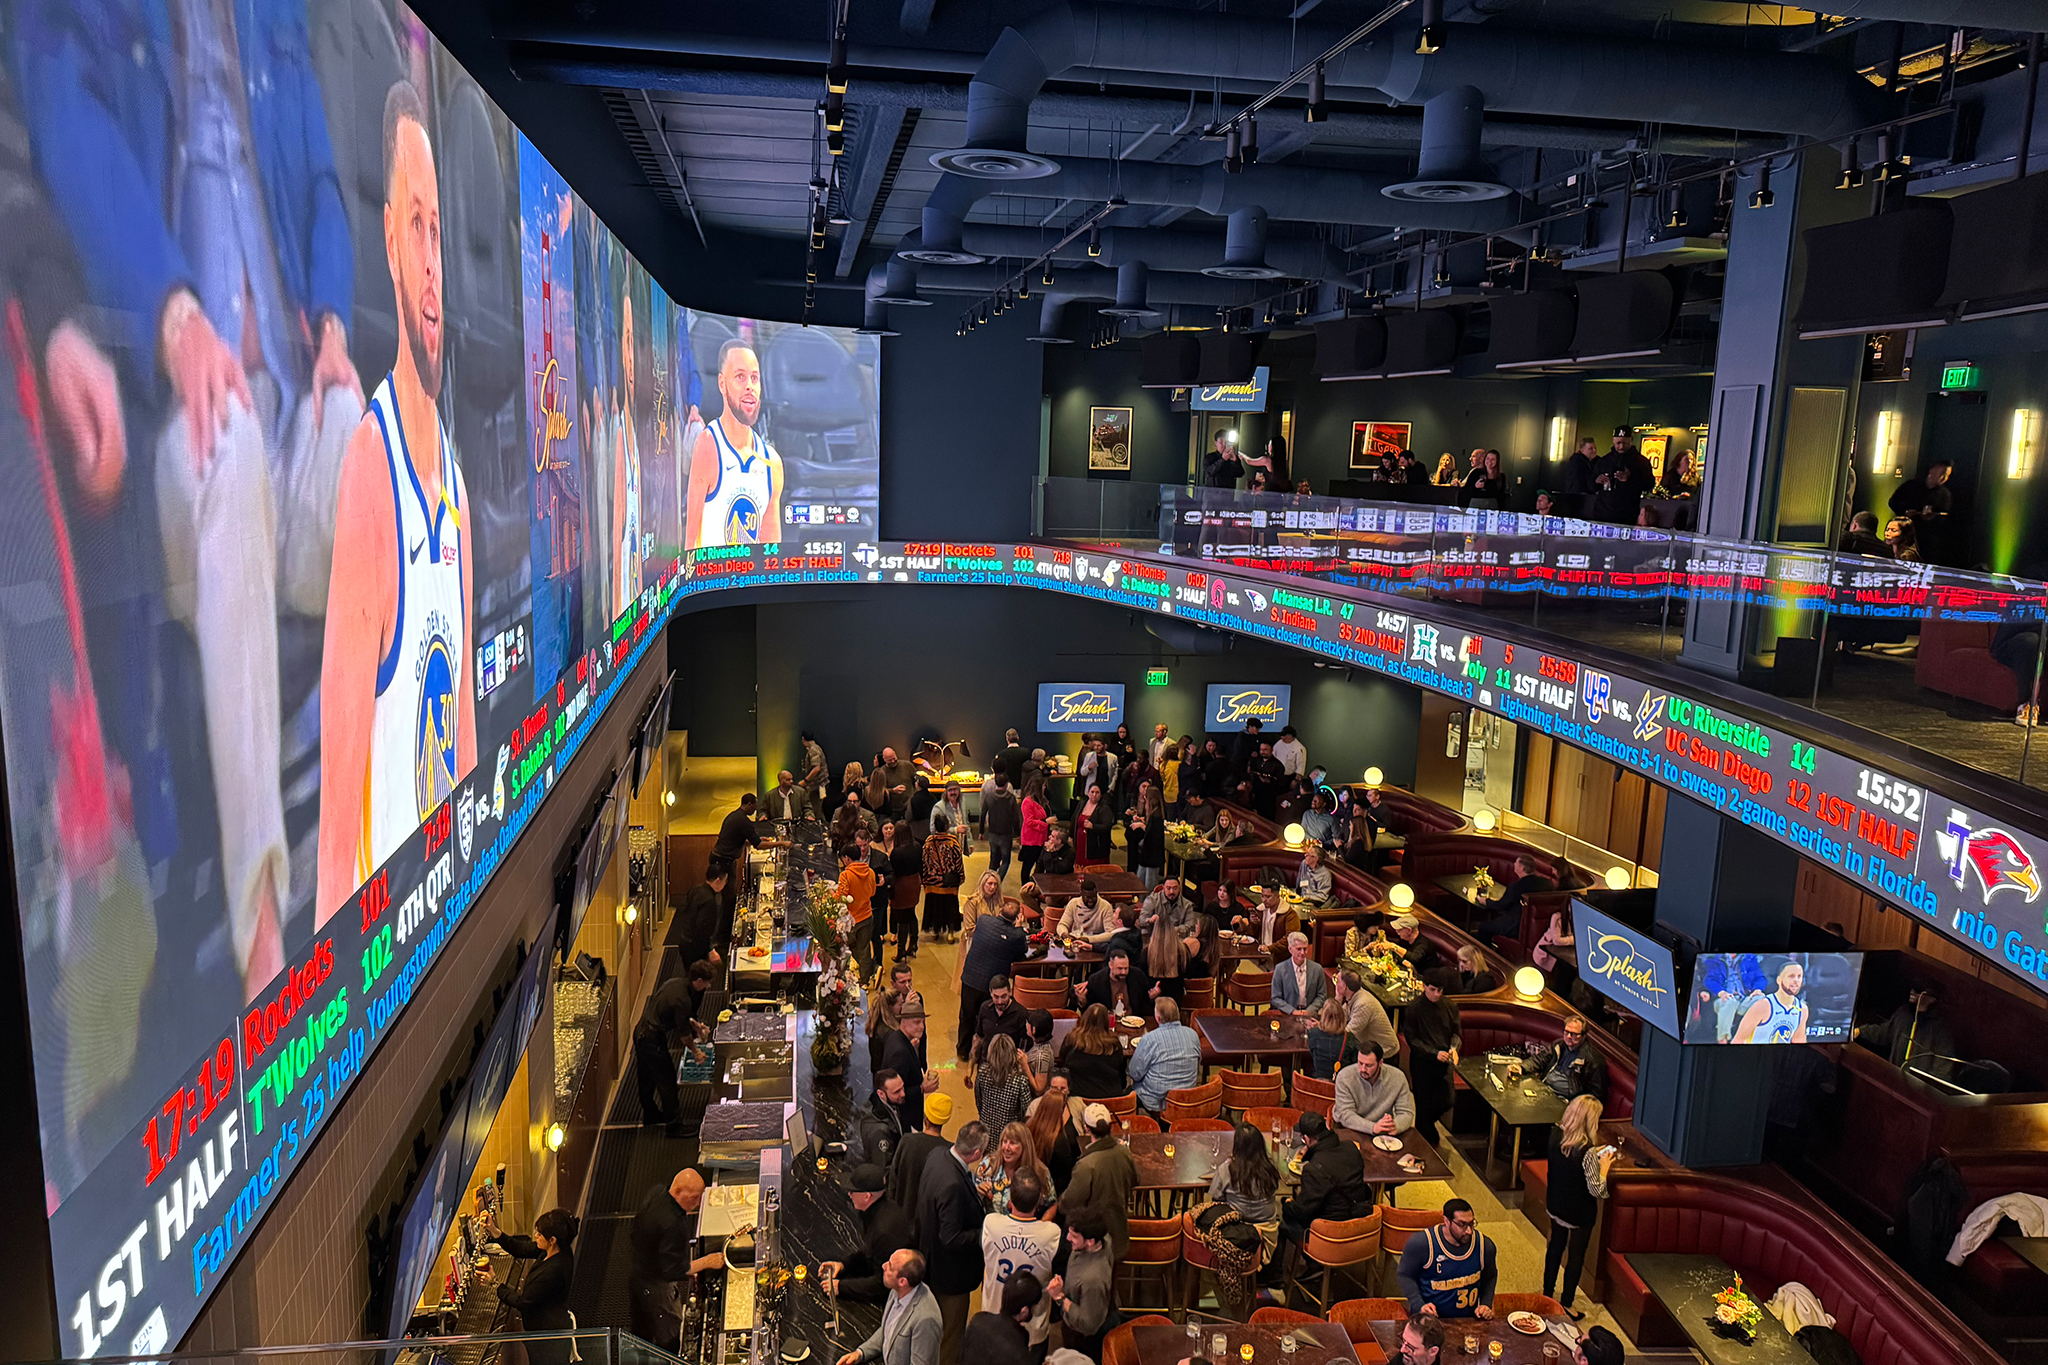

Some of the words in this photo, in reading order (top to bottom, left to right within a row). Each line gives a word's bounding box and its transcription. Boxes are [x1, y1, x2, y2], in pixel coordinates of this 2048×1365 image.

[1946, 369, 1966, 386] EXIT
[744, 512, 758, 532] 30
[696, 550, 707, 562] UC
[708, 544, 751, 560] Riverside
[764, 543, 779, 556] 14
[804, 542, 842, 555] 15:52
[880, 556, 904, 569] 1ST
[906, 557, 942, 570] HALF
[904, 543, 941, 556] 17:19
[945, 544, 996, 557] Rockets
[1014, 546, 1034, 559] 101
[1053, 550, 1071, 564] 7:18
[696, 564, 708, 576] UC
[708, 562, 724, 574] San
[726, 560, 755, 576] Diego
[764, 558, 778, 570] 12
[782, 558, 804, 570] 1ST
[809, 558, 843, 569] HALF
[698, 580, 705, 592] to
[704, 577, 729, 592] sweep
[731, 574, 766, 588] 2-game
[769, 572, 801, 584] series
[803, 570, 814, 582] in
[818, 570, 858, 582] Florida
[945, 558, 1003, 571] T'Wolves
[1013, 560, 1034, 572] 102
[1036, 562, 1052, 576] 4TH
[1053, 564, 1070, 580] QTR
[1089, 566, 1101, 578] vs.
[1122, 560, 1134, 574] St.
[1134, 563, 1167, 580] Thomas
[1187, 572, 1206, 588] 0:02
[918, 571, 968, 584] Farmer's
[972, 572, 984, 584] 25
[988, 572, 1012, 586] help
[1014, 574, 1063, 590] Youngstown
[1064, 580, 1082, 594] State
[1083, 584, 1106, 599] defeat
[1107, 588, 1137, 605] Oakland
[1137, 594, 1158, 610] 84-75
[1121, 576, 1130, 590] S.
[1131, 578, 1160, 596] Dakota
[1160, 582, 1170, 598] St
[1184, 587, 1206, 605] HALF
[1227, 592, 1240, 606] vs.
[1272, 588, 1313, 612] Arkansas
[1314, 598, 1333, 616] L.R.
[1340, 602, 1355, 620] 47
[1377, 611, 1407, 634] 14:57
[415, 609, 440, 683] GOLDEN
[1271, 606, 1280, 622] S.
[1281, 608, 1317, 632] Indiana
[1339, 622, 1353, 640] 35
[1354, 626, 1376, 649] 2ND
[1378, 632, 1406, 655] HALF
[1182, 606, 1206, 620] scores
[1208, 609, 1219, 624] his
[1220, 612, 1242, 630] 879th
[1244, 618, 1252, 632] to
[1254, 623, 1276, 638] move
[1276, 626, 1302, 645] closer
[1302, 634, 1312, 648] to
[1313, 637, 1353, 664] Gretzky's
[1354, 649, 1386, 672] record,
[1387, 659, 1400, 674] as
[1400, 660, 1440, 688] Capitals
[1440, 672, 1464, 696] beat
[1440, 644, 1456, 662] vs.
[1504, 644, 1514, 665] 5
[1538, 654, 1577, 685] 15:58
[1495, 667, 1512, 690] 11
[1514, 673, 1539, 698] 1ST
[1539, 681, 1574, 711] HALF
[439, 692, 454, 753] 30
[1048, 690, 1118, 723] Splash
[1216, 690, 1284, 723] Splash
[1612, 698, 1632, 722] vs.
[511, 728, 523, 761] St.
[522, 702, 548, 748] Thomas
[512, 768, 520, 800] S.
[520, 743, 544, 787] Dakota
[1668, 696, 1690, 726] UC
[1693, 704, 1771, 758] Riverside
[1791, 742, 1816, 776] 14
[1856, 769, 1921, 822] 15:52
[1500, 693, 1553, 732] Lightning
[1554, 711, 1581, 740] beat
[1583, 726, 1638, 765] Senators
[1641, 750, 1660, 776] 5-1
[1664, 759, 1680, 782] to
[1680, 771, 1727, 810] sweep
[1729, 788, 1787, 833] 2-game
[1790, 822, 1842, 864] series
[1845, 842, 1863, 876] in
[1868, 854, 1938, 917] Florida
[1664, 726, 1688, 756] UC
[1689, 738, 1720, 771] San
[1722, 750, 1772, 794] Diego
[1786, 778, 1812, 813] 12
[1816, 791, 1856, 832] 1ST
[1858, 811, 1917, 860] HALF
[476, 794, 490, 826] vs.
[244, 936, 334, 1070] Rockets
[360, 868, 391, 936] 101
[423, 802, 450, 863] 7:18
[1588, 934, 1668, 994] Splash
[248, 985, 348, 1136] T'Wolves
[360, 924, 394, 995] 102
[396, 882, 426, 945] 4TH
[426, 852, 452, 915] QTR
[192, 1117, 300, 1297] Farmer's
[301, 1073, 326, 1140] 25
[328, 1026, 366, 1104] help
[366, 917, 445, 1042] Youngstown
[445, 883, 471, 933] State
[470, 836, 500, 894] defeat
[499, 794, 529, 856] Oakland
[142, 1037, 236, 1188] 17:19
[72, 1220, 148, 1360] 1ST
[156, 1109, 239, 1260] HALF
[994, 1236, 1042, 1258] LOONEY
[1456, 1288, 1478, 1308] 30
